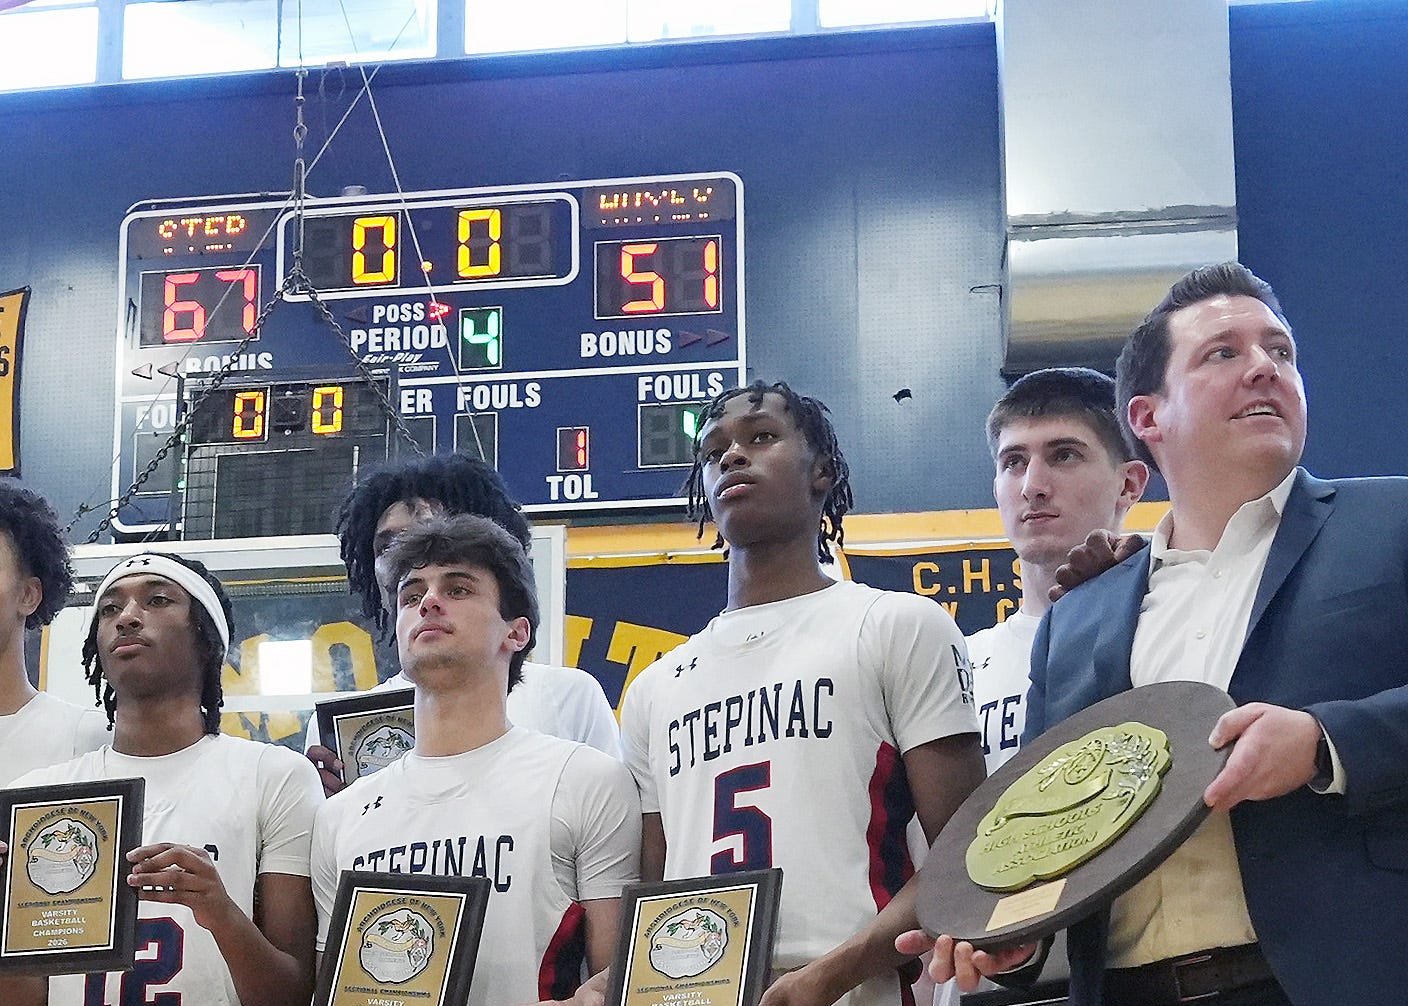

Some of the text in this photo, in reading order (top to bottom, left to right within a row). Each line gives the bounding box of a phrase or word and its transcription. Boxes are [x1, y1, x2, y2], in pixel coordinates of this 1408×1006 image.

[620, 240, 718, 314] 51
[163, 269, 257, 342] 67
[373, 302, 425, 324] POSS
[350, 324, 447, 352] PERIOD
[463, 311, 498, 365] 4
[581, 328, 672, 358] BONUS
[457, 382, 542, 411] FOULS
[638, 372, 724, 401] FOULS
[232, 390, 264, 439] 0
[311, 386, 344, 434] 0
[576, 430, 586, 468] 1
[546, 474, 598, 500] TOL
[668, 678, 833, 777] STEPINAC
[710, 760, 772, 875] 5
[31, 917, 86, 927] BASKETBALL
[41, 909, 78, 918] VARSITY
[33, 927, 84, 937] CHAMPIONS
[367, 998, 404, 1006] VARSITY
[662, 991, 703, 1002] VARSITY
